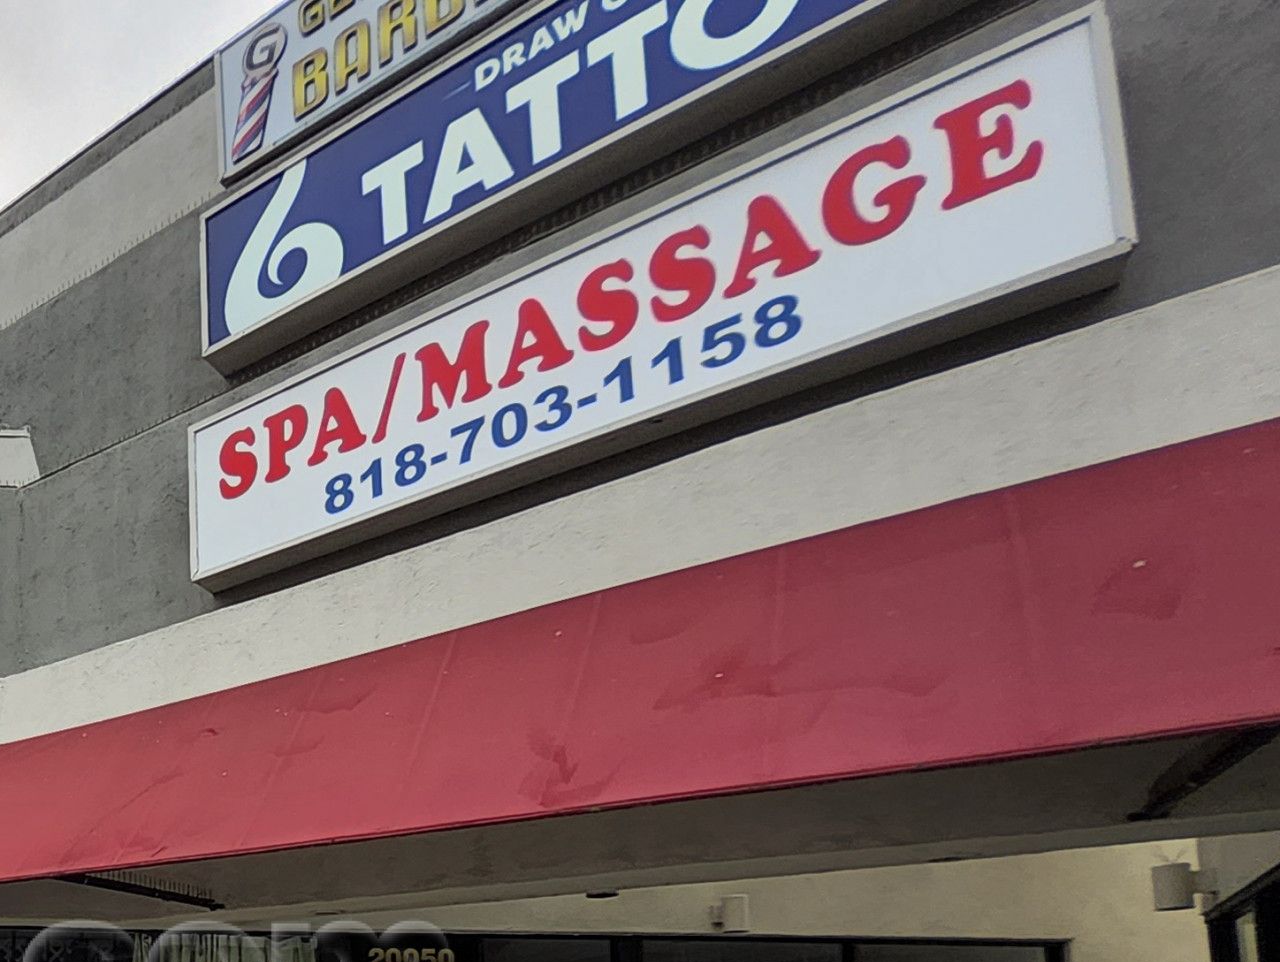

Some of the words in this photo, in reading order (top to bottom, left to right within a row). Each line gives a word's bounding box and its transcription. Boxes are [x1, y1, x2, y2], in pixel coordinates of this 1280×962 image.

[474, 0, 589, 92] DRAW
[218, 79, 1044, 501] SPA/MASSAGE
[323, 294, 804, 515] 818-703-1158
